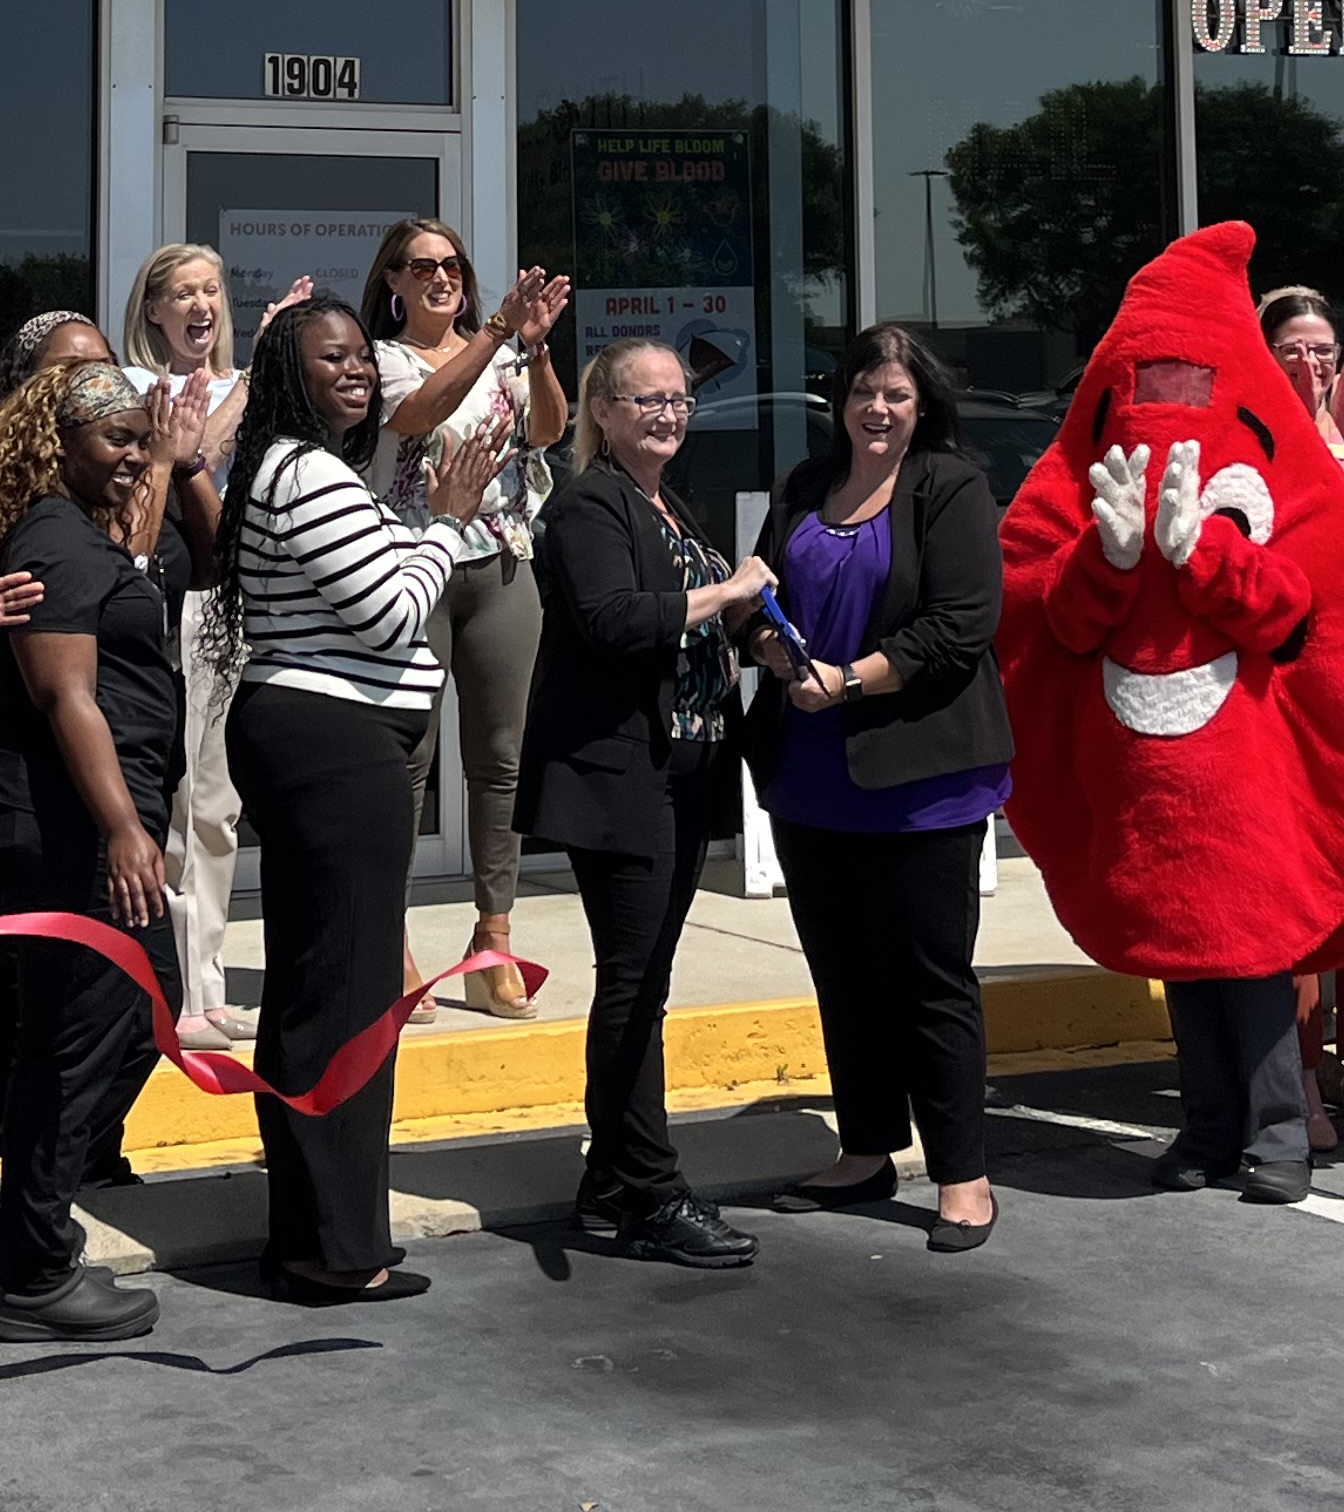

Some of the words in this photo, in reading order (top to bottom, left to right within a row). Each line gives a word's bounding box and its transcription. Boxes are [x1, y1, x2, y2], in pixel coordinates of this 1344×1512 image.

[267, 55, 358, 98] 1904
[598, 139, 635, 154] HELP
[639, 139, 670, 154] LIFE
[674, 139, 725, 154] BLOOM
[598, 160, 649, 182] GIVE
[655, 160, 726, 182] BLOOD
[230, 222, 287, 237] HOURS
[290, 223, 310, 237] OF
[315, 268, 359, 279] CLOSED
[233, 298, 268, 308] Tuesda
[606, 296, 660, 316] APRIL
[667, 296, 675, 314] 1
[703, 295, 727, 314] 30
[585, 326, 609, 338] ALL
[611, 324, 661, 338] DONORS
